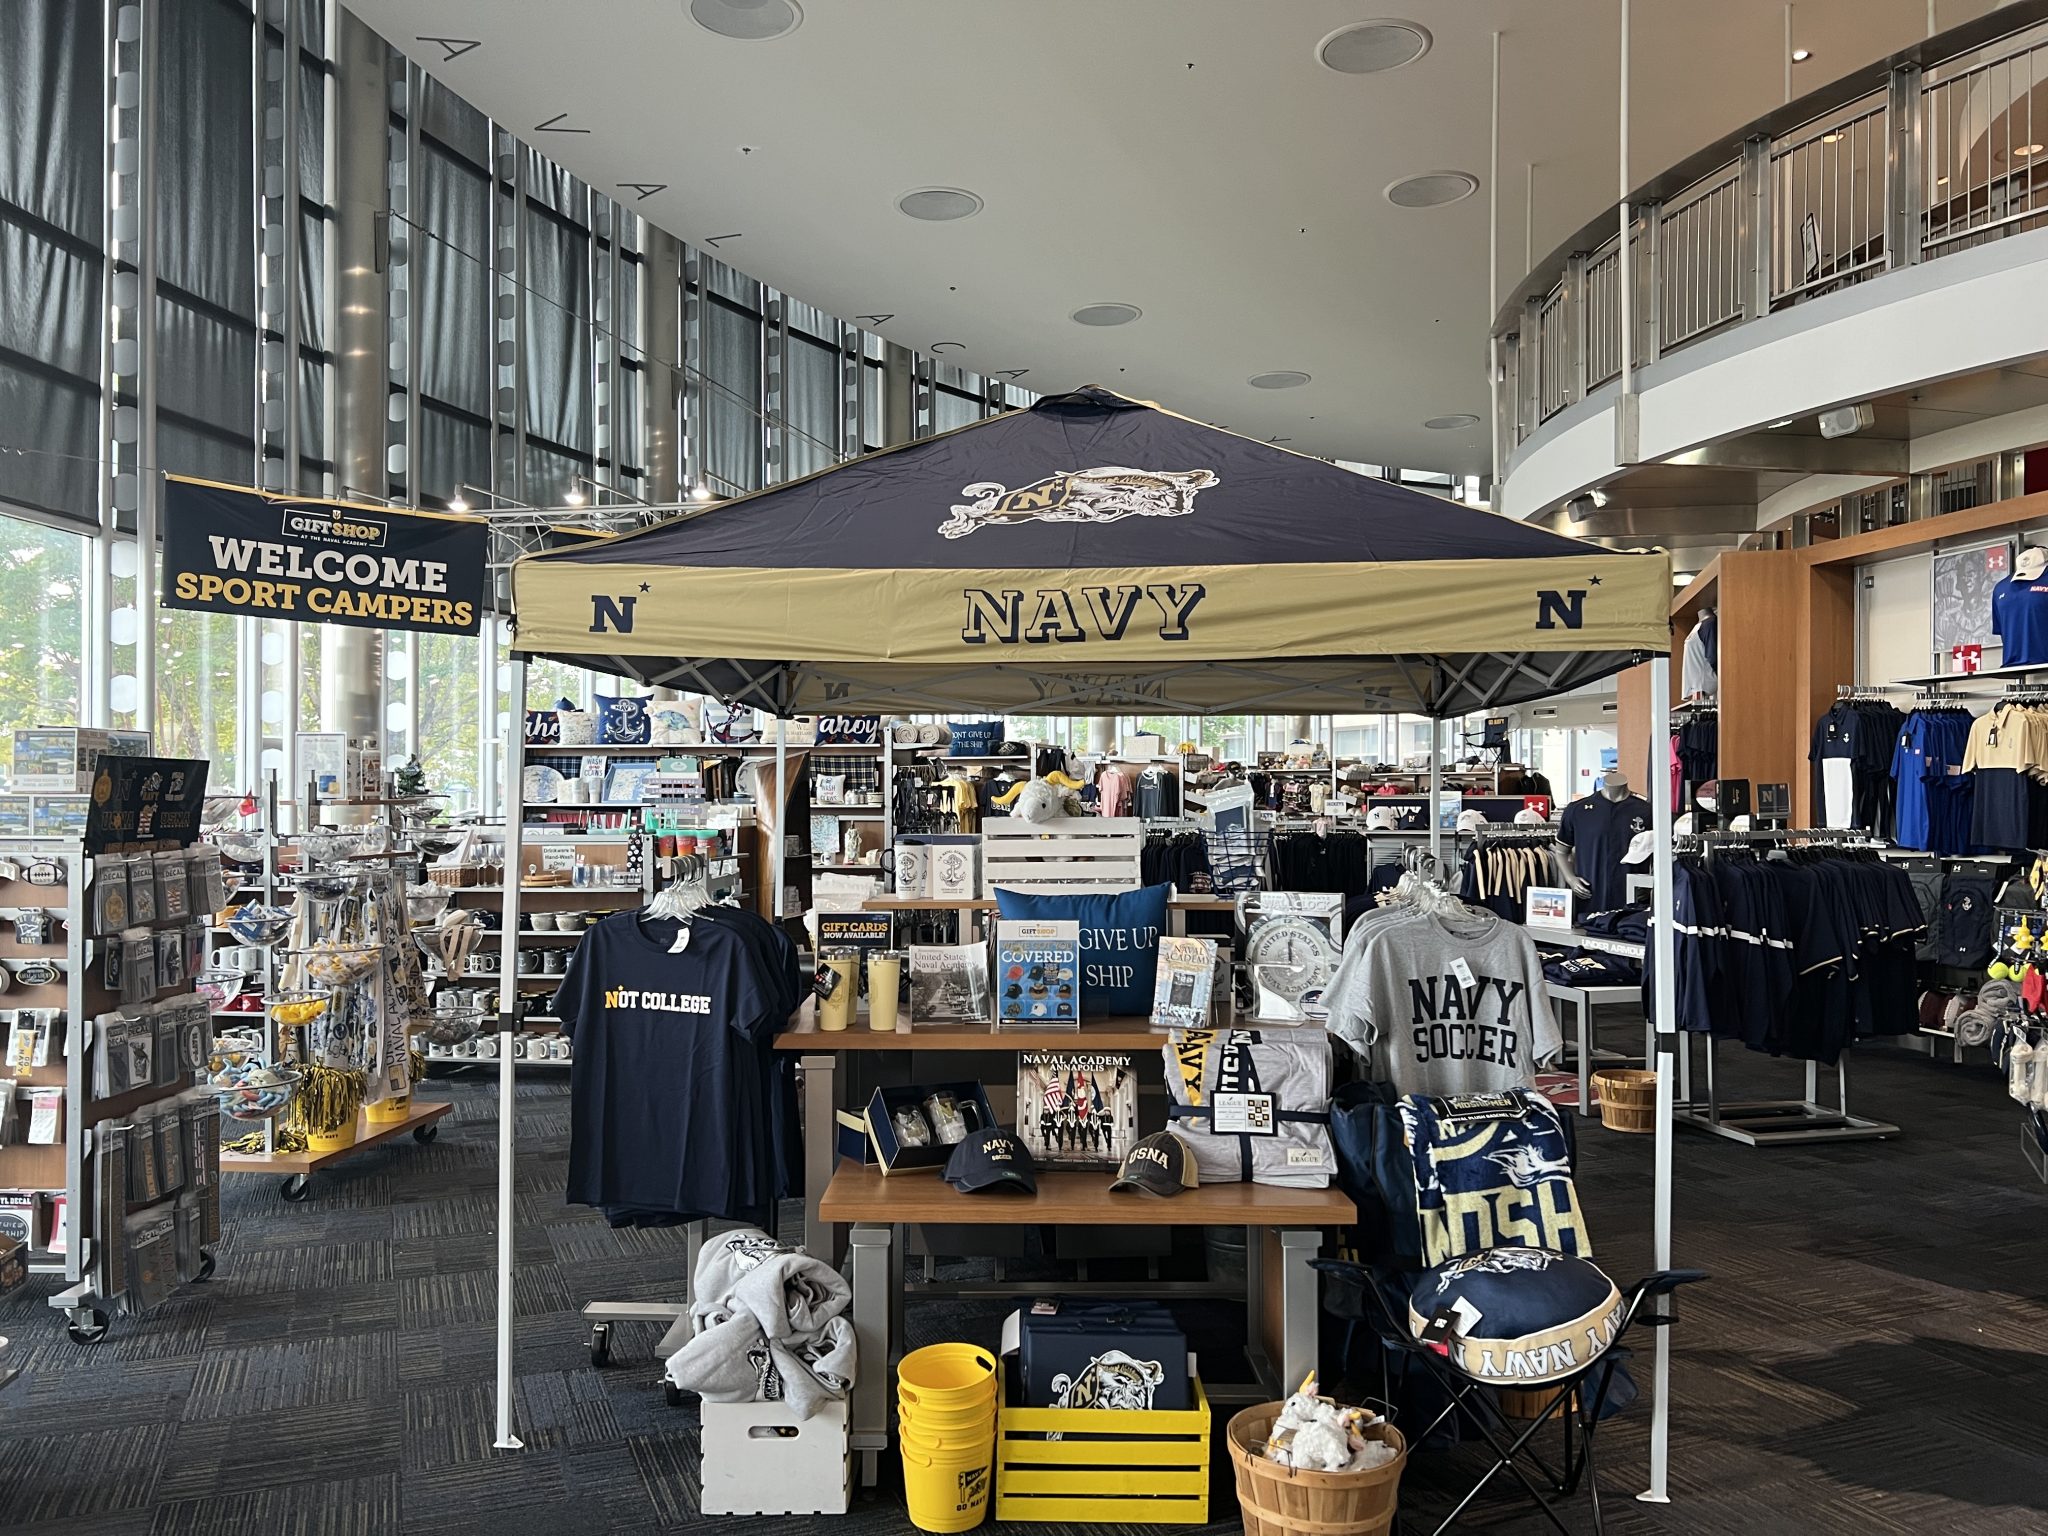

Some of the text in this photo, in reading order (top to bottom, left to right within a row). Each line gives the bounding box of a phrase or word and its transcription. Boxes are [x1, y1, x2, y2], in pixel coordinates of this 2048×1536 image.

[342, 539, 368, 547] ACADEMY
[209, 535, 448, 594] WELCOME
[175, 572, 473, 627] SPORT CAMPERS
[1535, 590, 1587, 629] N
[589, 594, 637, 633] N
[961, 584, 1207, 644] NAVY
[525, 713, 560, 738] aho
[820, 715, 878, 743] ahoy
[968, 731, 983, 739] GIVE
[166, 868, 185, 877] DECAL
[822, 922, 888, 932] GIFT CARDS
[1078, 926, 1158, 950] GIVE UP
[1261, 931, 1288, 957] UNITED
[1290, 931, 1320, 957] STATES
[1582, 939, 1610, 952] UNDER
[914, 953, 941, 961] United
[914, 961, 938, 969] Naval
[1001, 951, 1074, 963] COVERED
[1086, 964, 1134, 988] SHIP
[1284, 966, 1321, 993] ACADEMY
[605, 989, 711, 1015] NOT COLLEGE
[1408, 974, 1524, 1026] NAVY
[1414, 1023, 1517, 1068] SOCCER
[1023, 1054, 1131, 1066] NAVAL ACADEMY
[1050, 1063, 1105, 1072] ANNAPOLIS
[1453, 1098, 1512, 1110] MIDSHIPMEN
[161, 1115, 179, 1128] DECAL
[982, 1138, 1015, 1154] NAVY
[1129, 1147, 1169, 1170] USNA
[10, 1197, 32, 1205] DECAL
[138, 1230, 158, 1244] DECAL
[1480, 1339, 1577, 1379] NAVY
[966, 1470, 982, 1482] NAVY
[956, 1494, 986, 1512] GO NAVY
